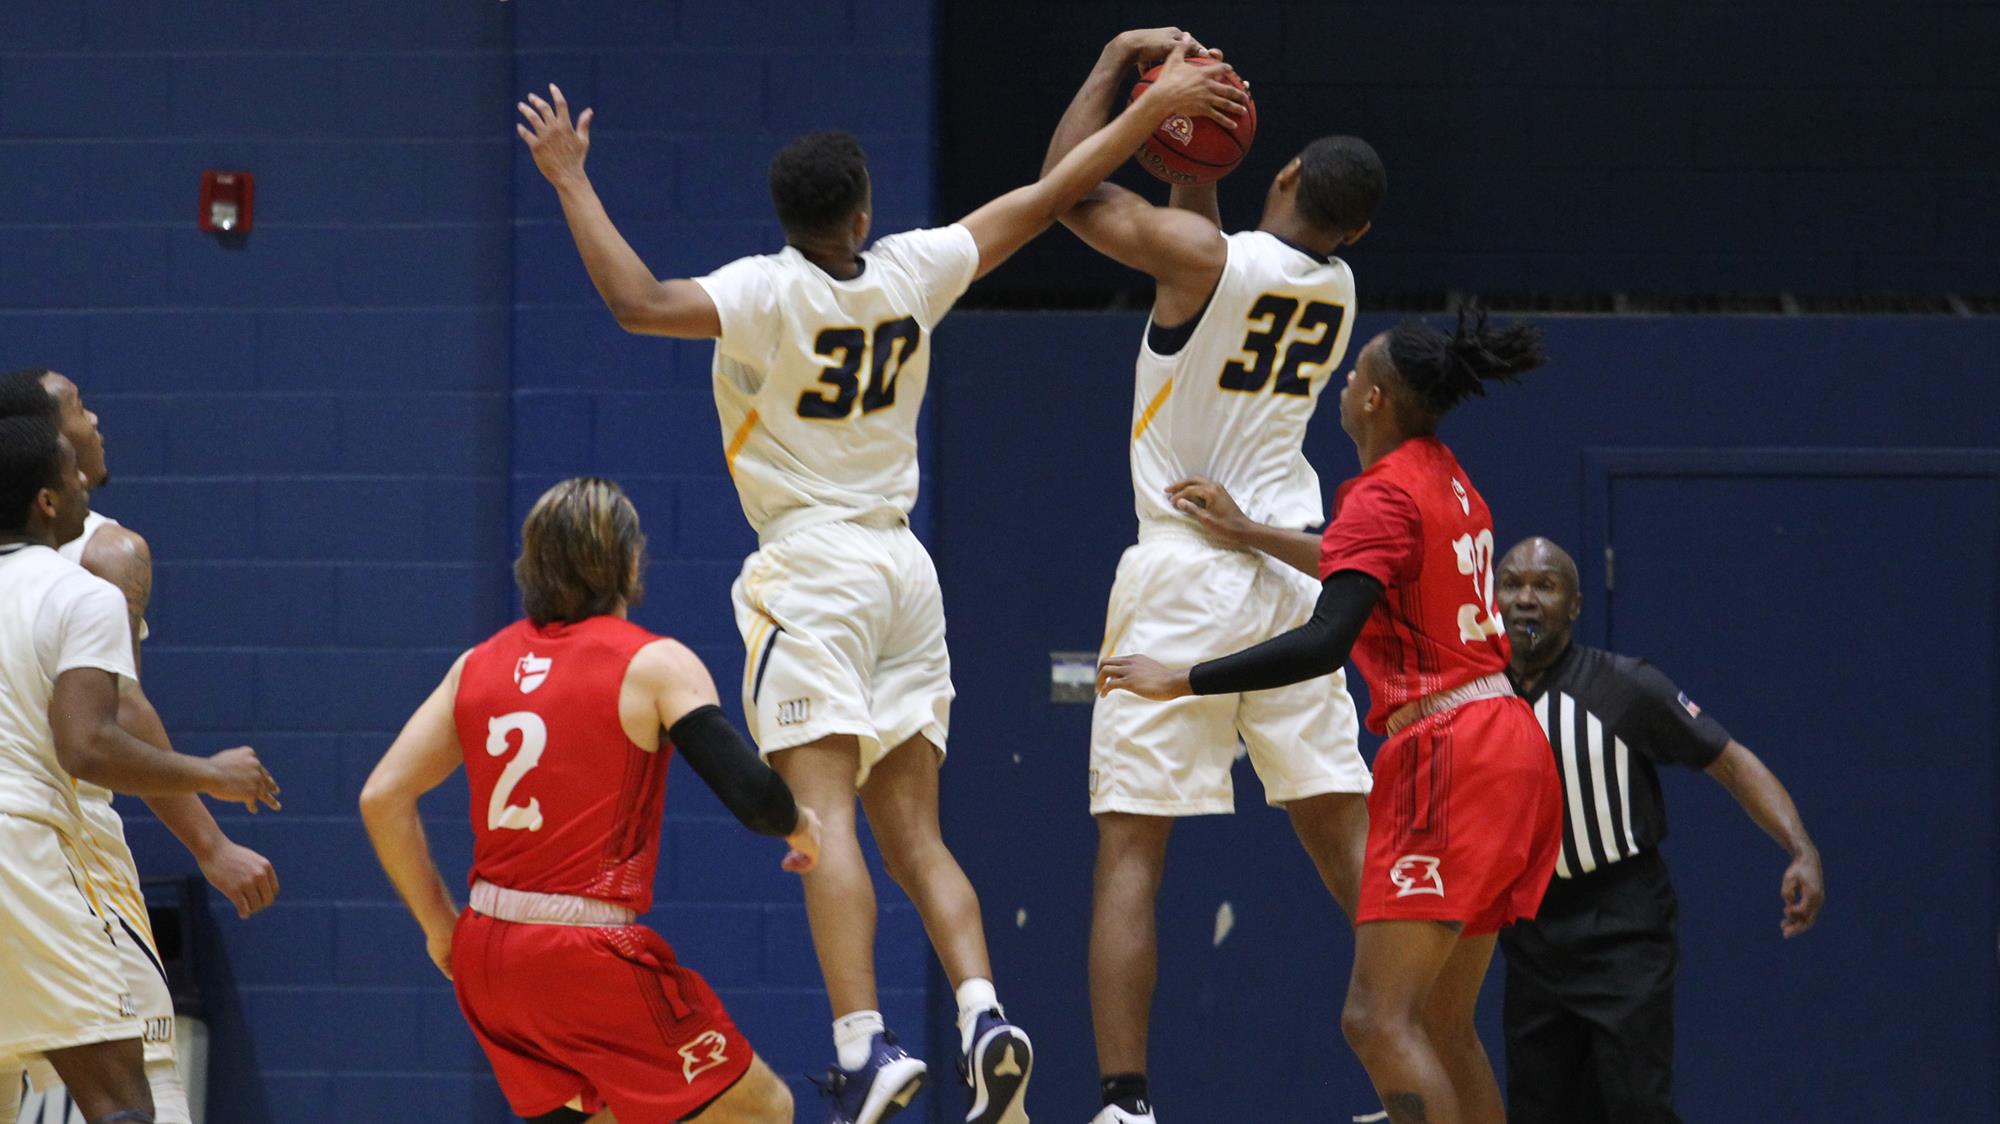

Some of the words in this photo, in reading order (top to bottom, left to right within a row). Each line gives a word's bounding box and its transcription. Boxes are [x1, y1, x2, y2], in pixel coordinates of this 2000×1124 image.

[796, 314, 921, 422] 30
[1217, 293, 1345, 398] 32
[486, 711, 547, 831] 2
